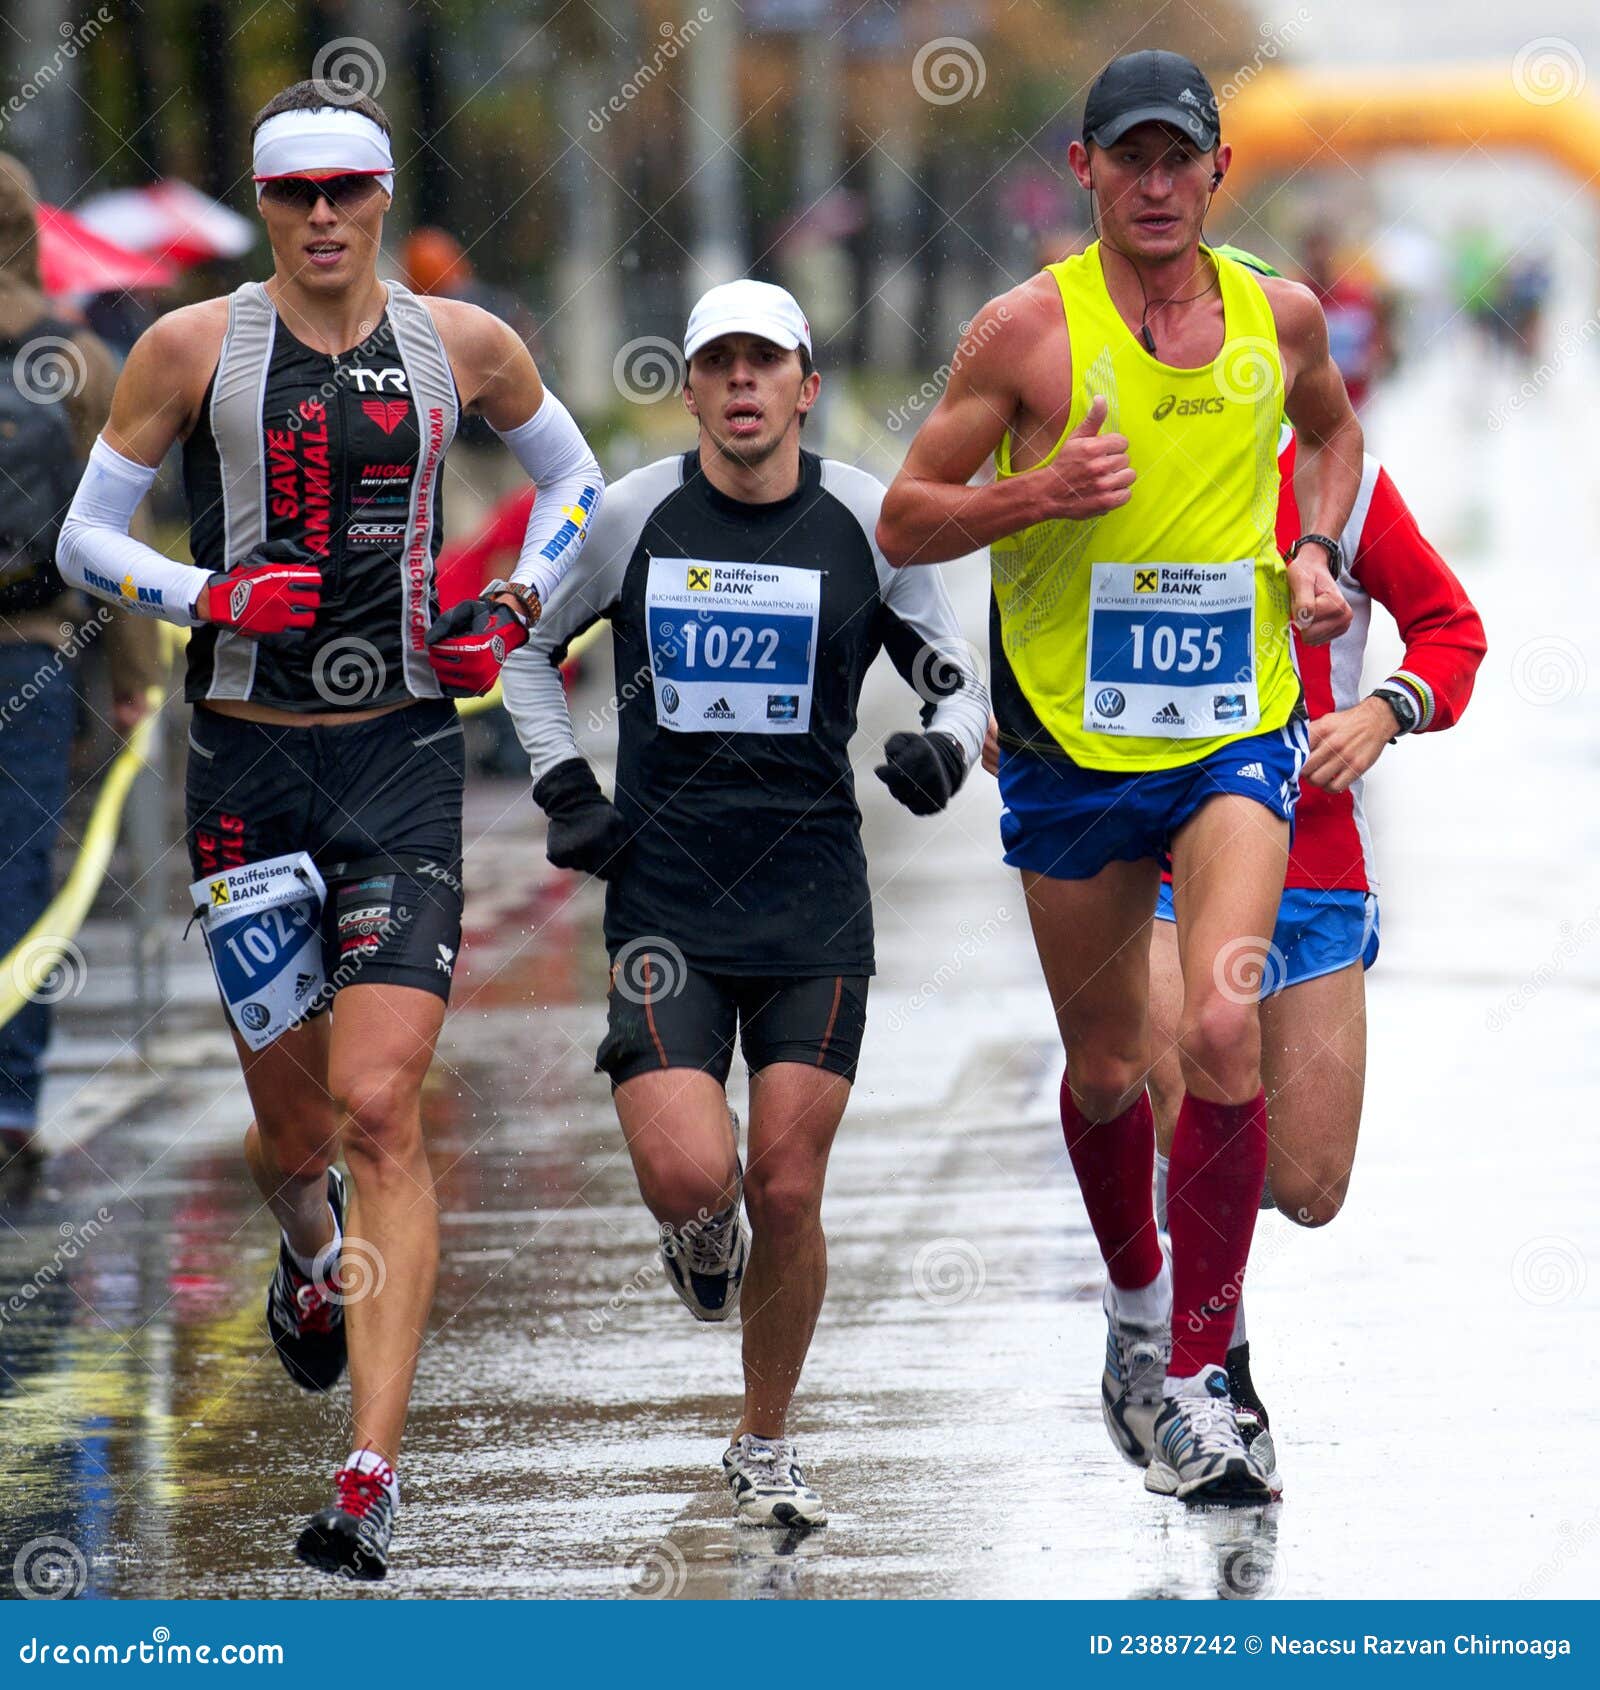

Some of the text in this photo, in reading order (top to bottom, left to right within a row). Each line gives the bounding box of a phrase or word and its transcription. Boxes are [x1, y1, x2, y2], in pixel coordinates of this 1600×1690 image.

[349, 367, 408, 392] TYR
[1176, 396, 1225, 416] asics
[266, 428, 299, 519] SAVE
[300, 400, 331, 557] ANIMALS
[714, 568, 780, 583] Raiffeisen
[1161, 568, 1227, 582] Raiffeisen
[713, 582, 753, 595] BANK
[1161, 582, 1203, 595] BANK
[651, 592, 814, 610] BUCHAREST INTERNATIONAL MARATHON 2011
[1096, 596, 1138, 605] BUCHAREST
[1140, 597, 1198, 608] INTERNATIONAL
[1200, 597, 1237, 608] MARATHON
[684, 623, 780, 670] 1022
[1130, 624, 1223, 673] 1055
[703, 711, 736, 720] adidas
[1152, 715, 1186, 725] adidas
[228, 865, 291, 888] Raiffeisen
[232, 882, 270, 902] BANK
